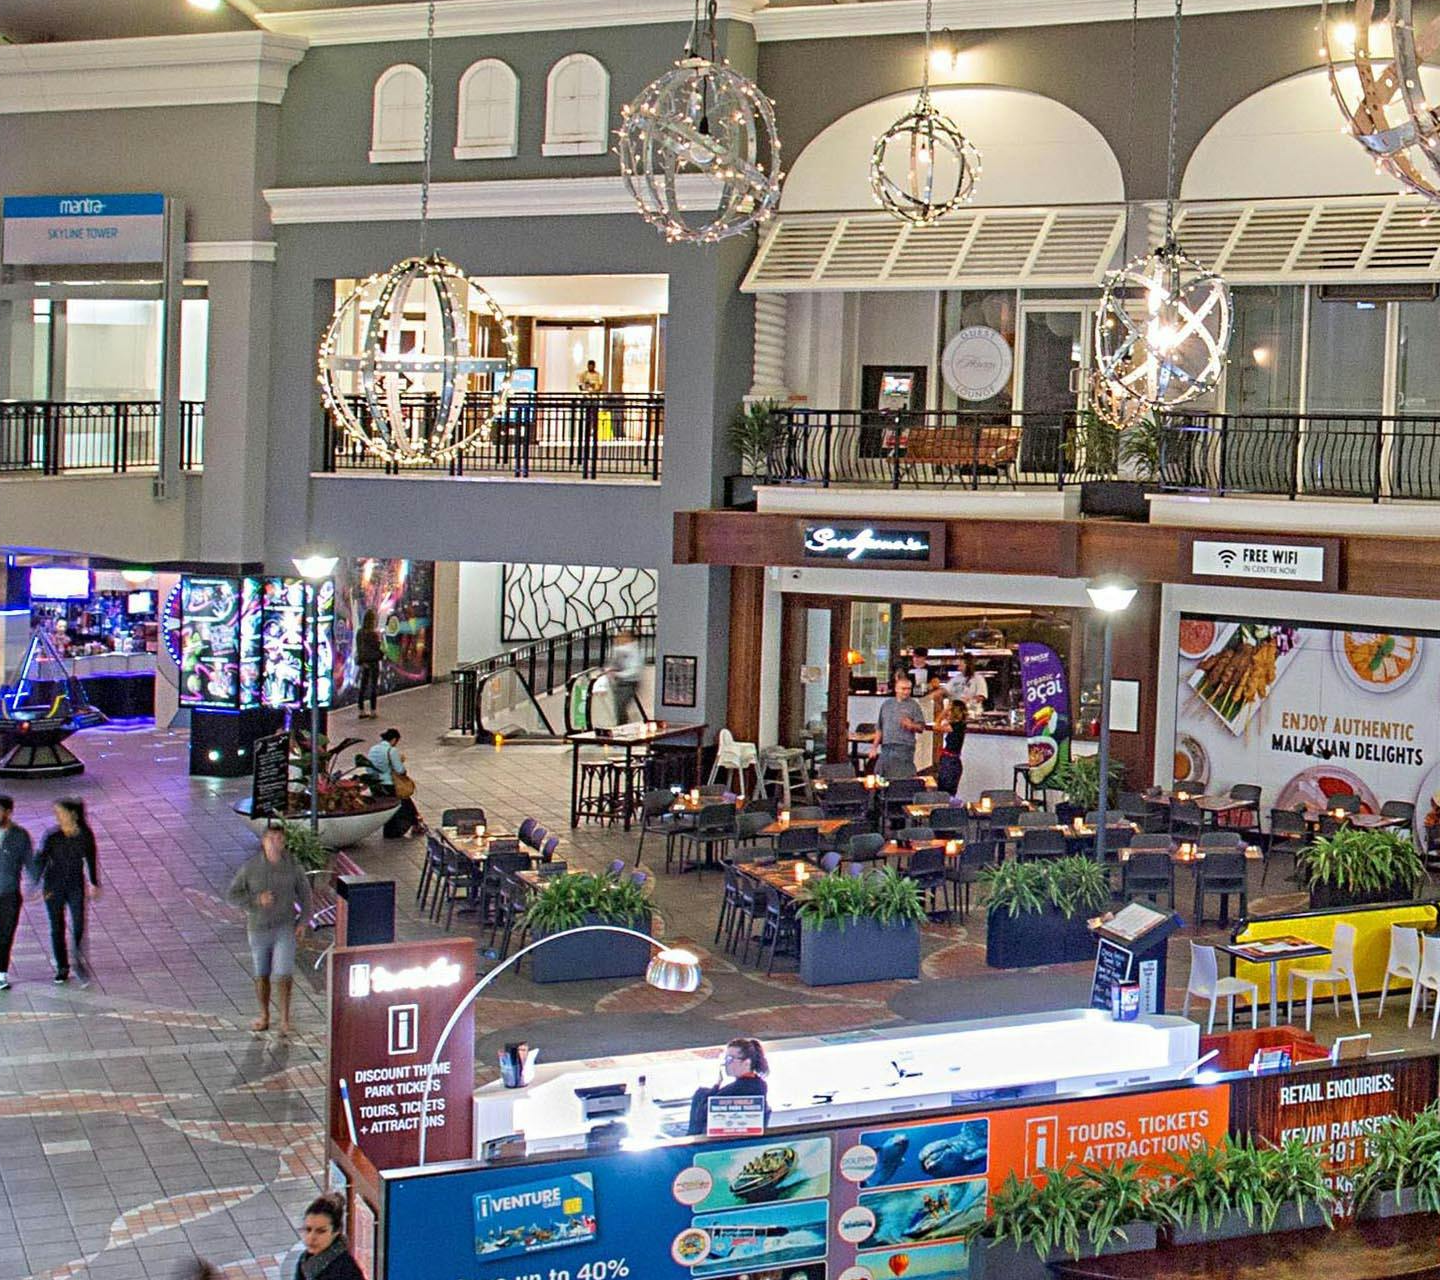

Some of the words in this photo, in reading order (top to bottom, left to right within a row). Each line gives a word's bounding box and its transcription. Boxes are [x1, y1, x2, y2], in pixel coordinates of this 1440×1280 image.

[59, 198, 107, 214] mantra
[48, 228, 83, 240] SKYLINE
[86, 227, 119, 239] TOWER
[1243, 548, 1268, 563] FREE
[1272, 550, 1298, 565] WIFI
[1252, 566, 1278, 574] CENTRE
[1279, 567, 1297, 575] NOW
[1026, 674, 1054, 687] organic
[1027, 672, 1063, 704] açaí
[1281, 712, 1328, 733] ENJOY
[1332, 717, 1415, 742] AUTHENTIC
[1271, 733, 1350, 759] MALAYSIAN
[1355, 742, 1424, 766] DELIGHTS
[355, 1066, 410, 1083] DISCOUNT
[364, 1084, 394, 1099] PARK
[1280, 1082, 1324, 1106] RETAIL
[1327, 1073, 1395, 1100] ENQUIRIES:
[360, 1104, 399, 1119] TOURS,
[370, 1114, 446, 1134] ATTRACTONS
[1067, 1120, 1132, 1144] TOURS,
[1138, 1109, 1210, 1135] TICKETS
[1331, 1114, 1392, 1140] RAMSE
[1083, 1132, 1202, 1164] ATTRACTIONS
